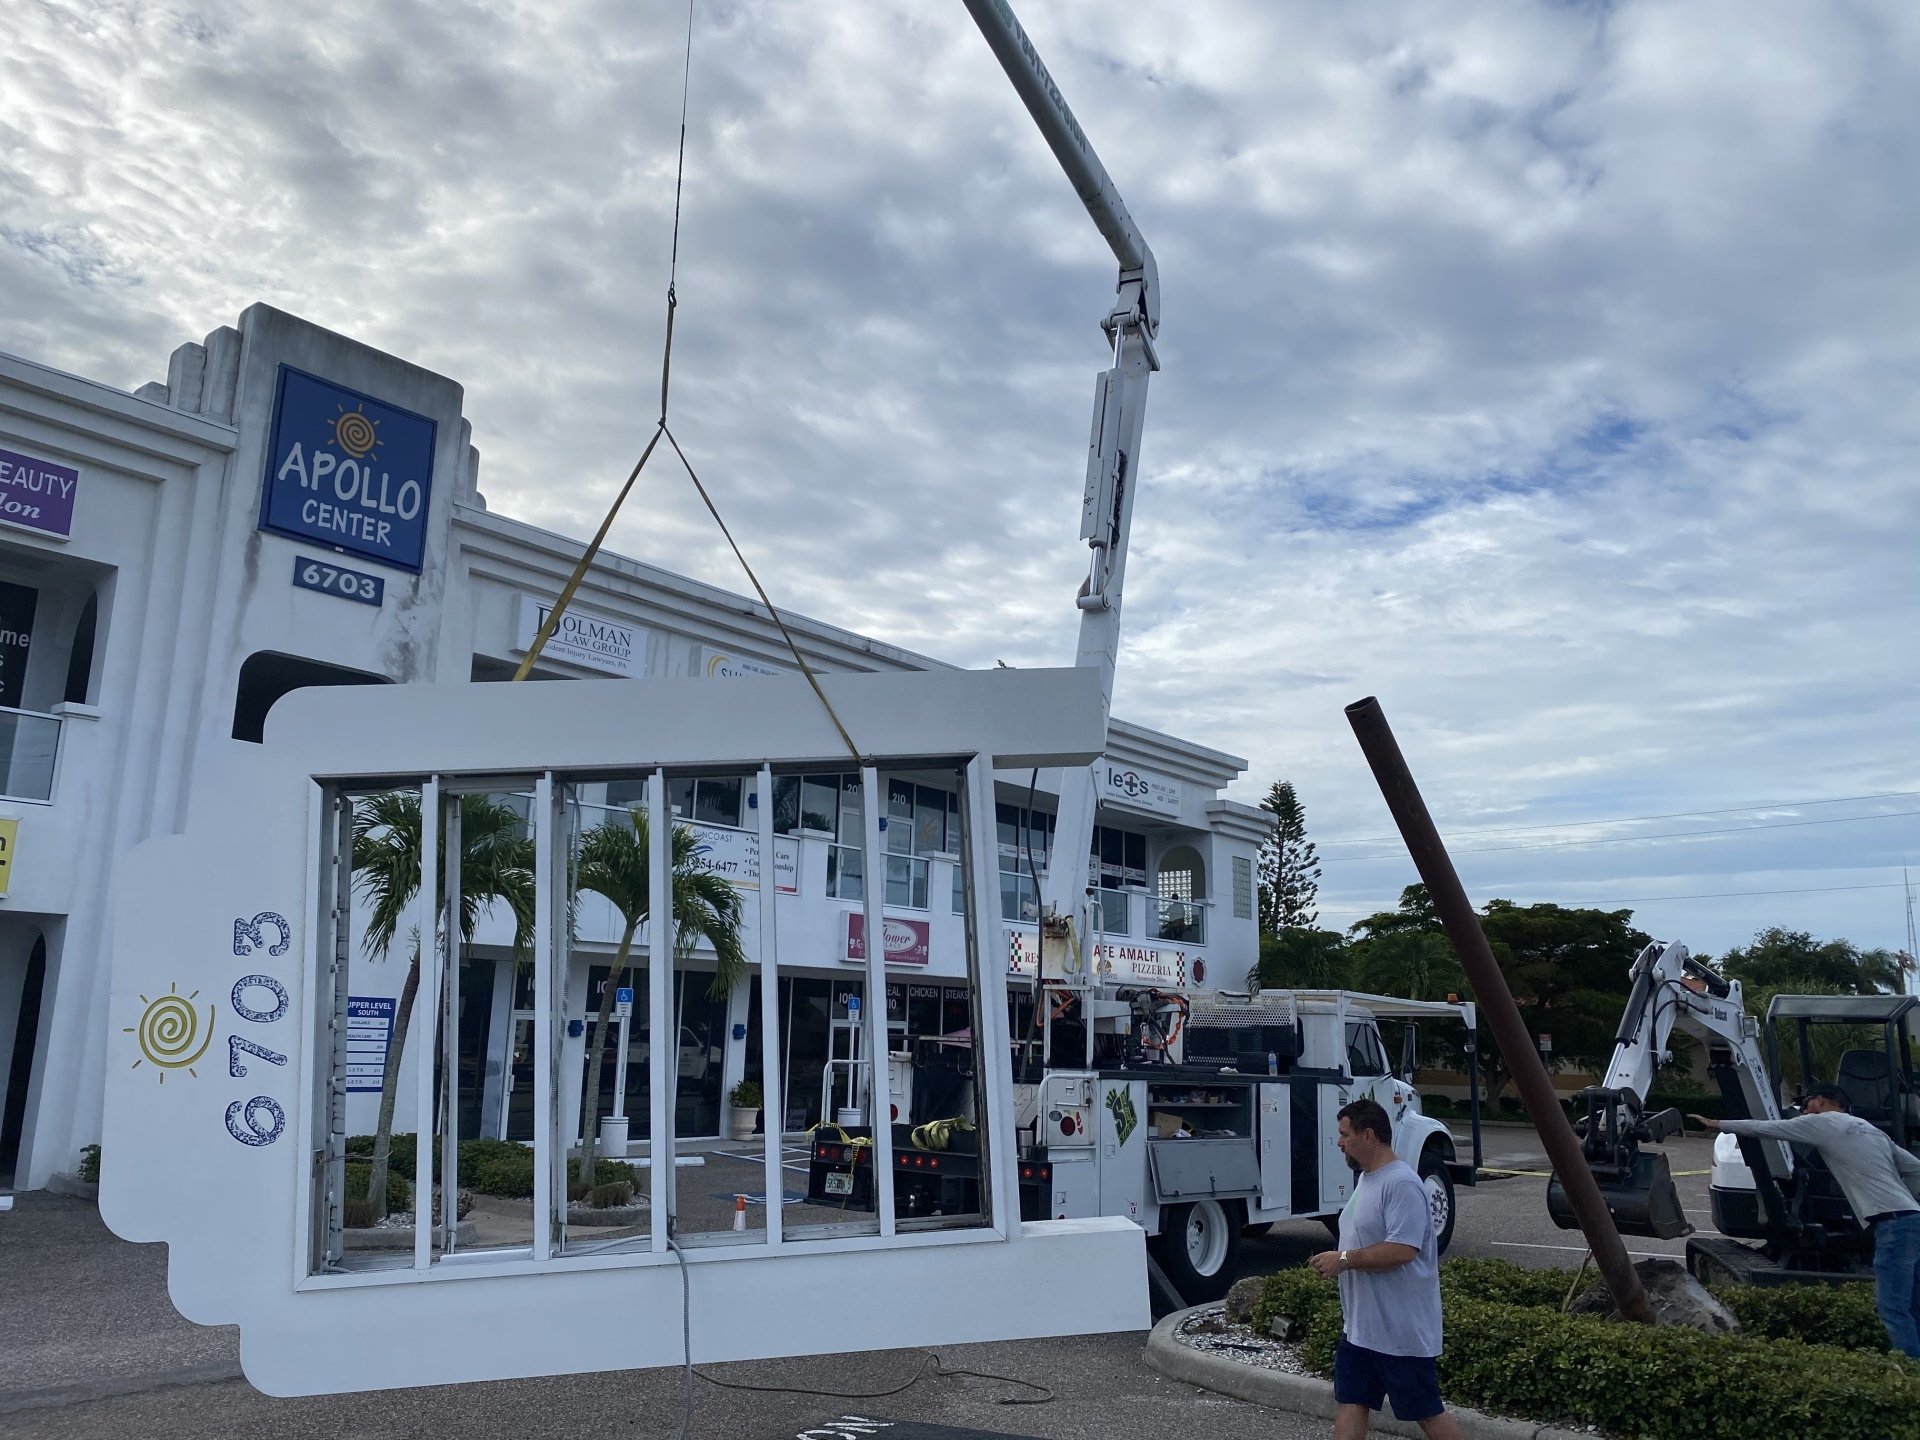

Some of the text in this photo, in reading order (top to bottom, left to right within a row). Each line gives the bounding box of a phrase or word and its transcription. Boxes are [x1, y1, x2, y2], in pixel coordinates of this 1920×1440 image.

[277, 441, 421, 520] APOLLO
[302, 498, 391, 546] CENTER
[302, 564, 376, 599] 6703
[564, 632, 631, 658] LAW GROUP
[567, 649, 587, 660] Injury
[588, 653, 617, 667] Lawyers,
[617, 661, 627, 669] PA
[892, 792, 906, 806] 210
[692, 829, 733, 843] SUNCOAST
[775, 851, 790, 861] Care
[882, 924, 911, 944] lower
[1119, 947, 1159, 963] AMALFI
[1132, 962, 1172, 976] PIZZERIA
[887, 985, 901, 997] EAL
[909, 986, 939, 998] CHICKEN
[945, 988, 969, 1000] STEAKS
[370, 1002, 392, 1010] LEVEL
[225, 911, 291, 1147] 6703
